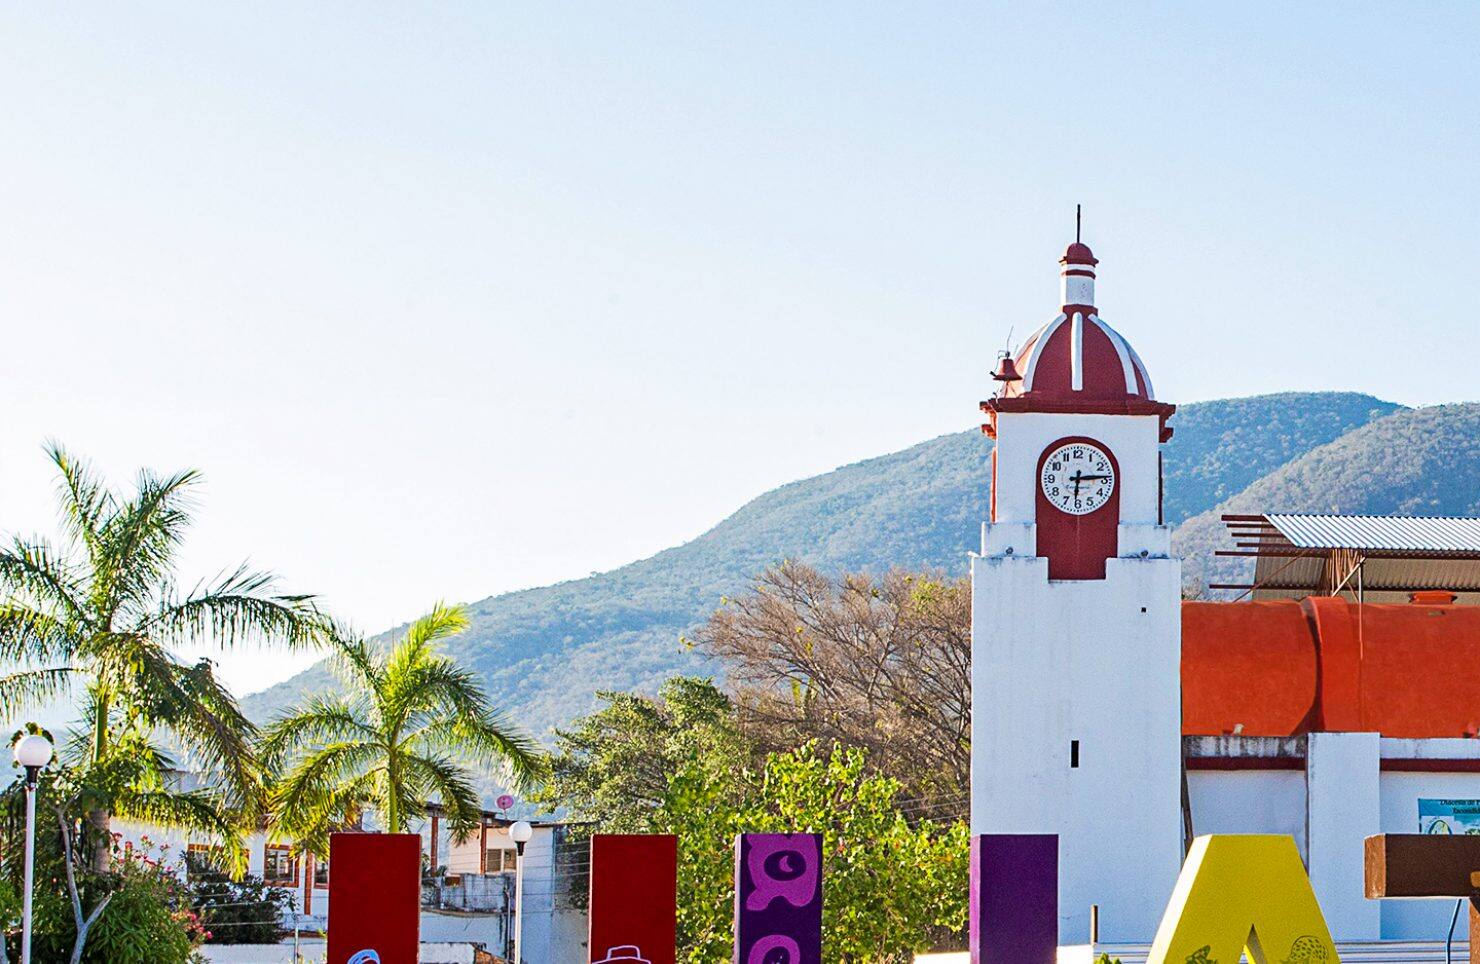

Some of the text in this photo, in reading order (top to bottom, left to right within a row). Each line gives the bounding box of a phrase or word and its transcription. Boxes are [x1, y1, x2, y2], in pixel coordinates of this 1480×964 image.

[1063, 453, 1069, 462] 11
[1073, 450, 1083, 459] 12
[1052, 462, 1061, 471] 10
[1096, 462, 1104, 471] 2
[1048, 474, 1055, 483] 9
[1052, 487, 1059, 496] 8
[1096, 488, 1103, 497] 4
[1063, 496, 1070, 505] 7
[1074, 499, 1081, 509] 6
[1086, 497, 1094, 506] 5
